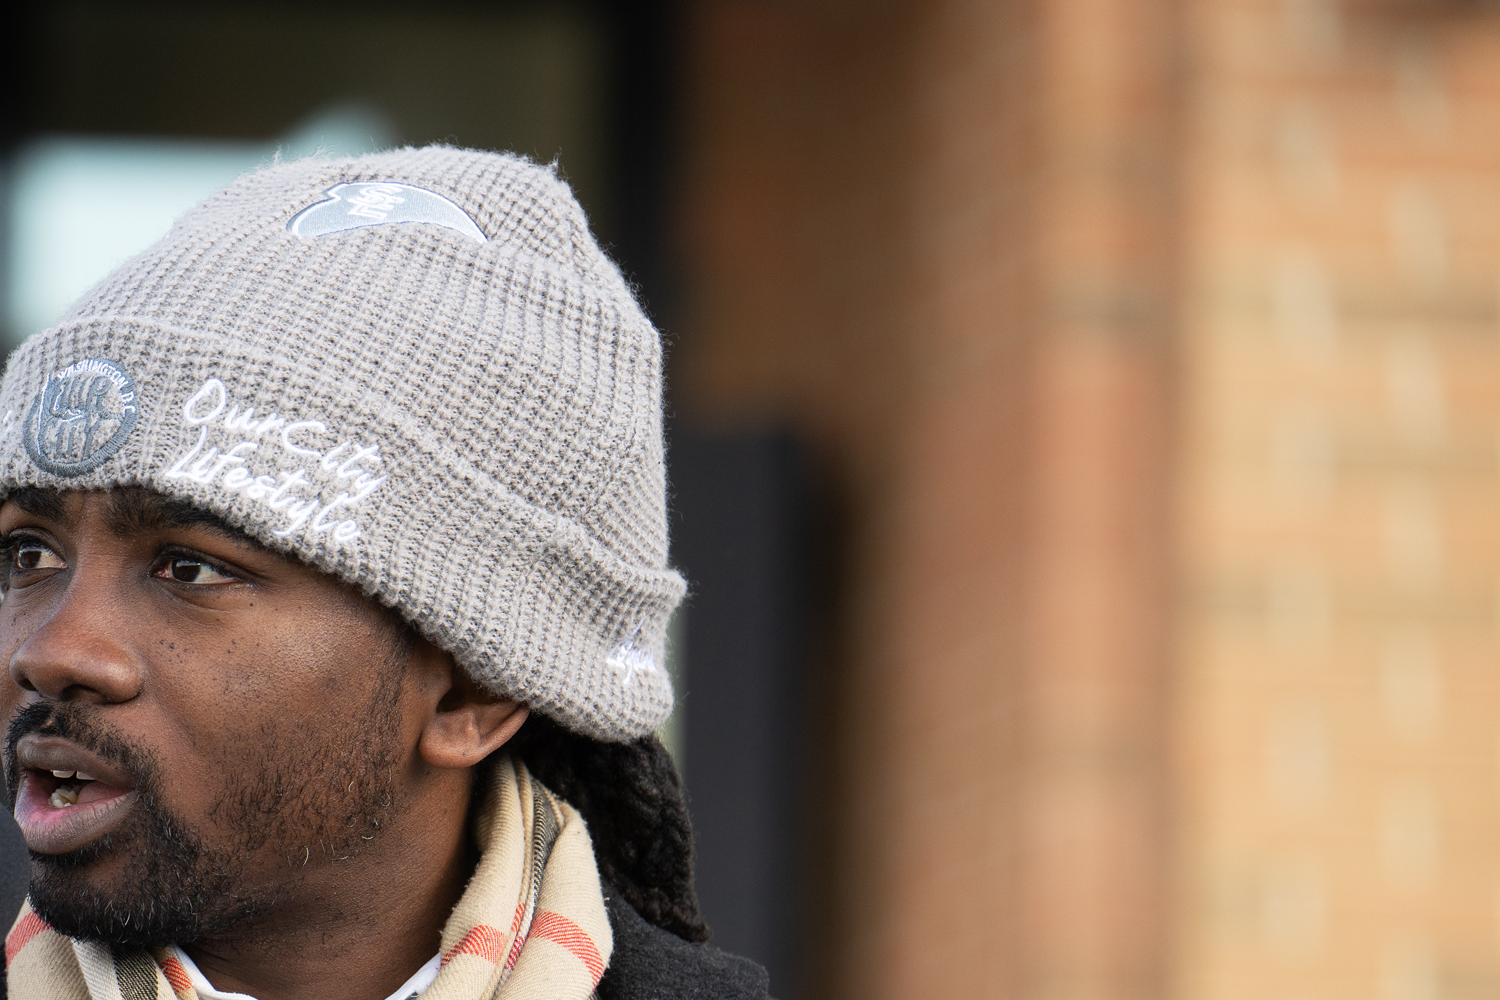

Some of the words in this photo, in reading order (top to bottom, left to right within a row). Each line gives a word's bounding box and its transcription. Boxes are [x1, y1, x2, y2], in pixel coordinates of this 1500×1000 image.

[56, 359, 129, 390] WASHINGTON
[165, 425, 362, 542] Lifestyle
[183, 378, 285, 434] Our
[282, 420, 388, 502] City
